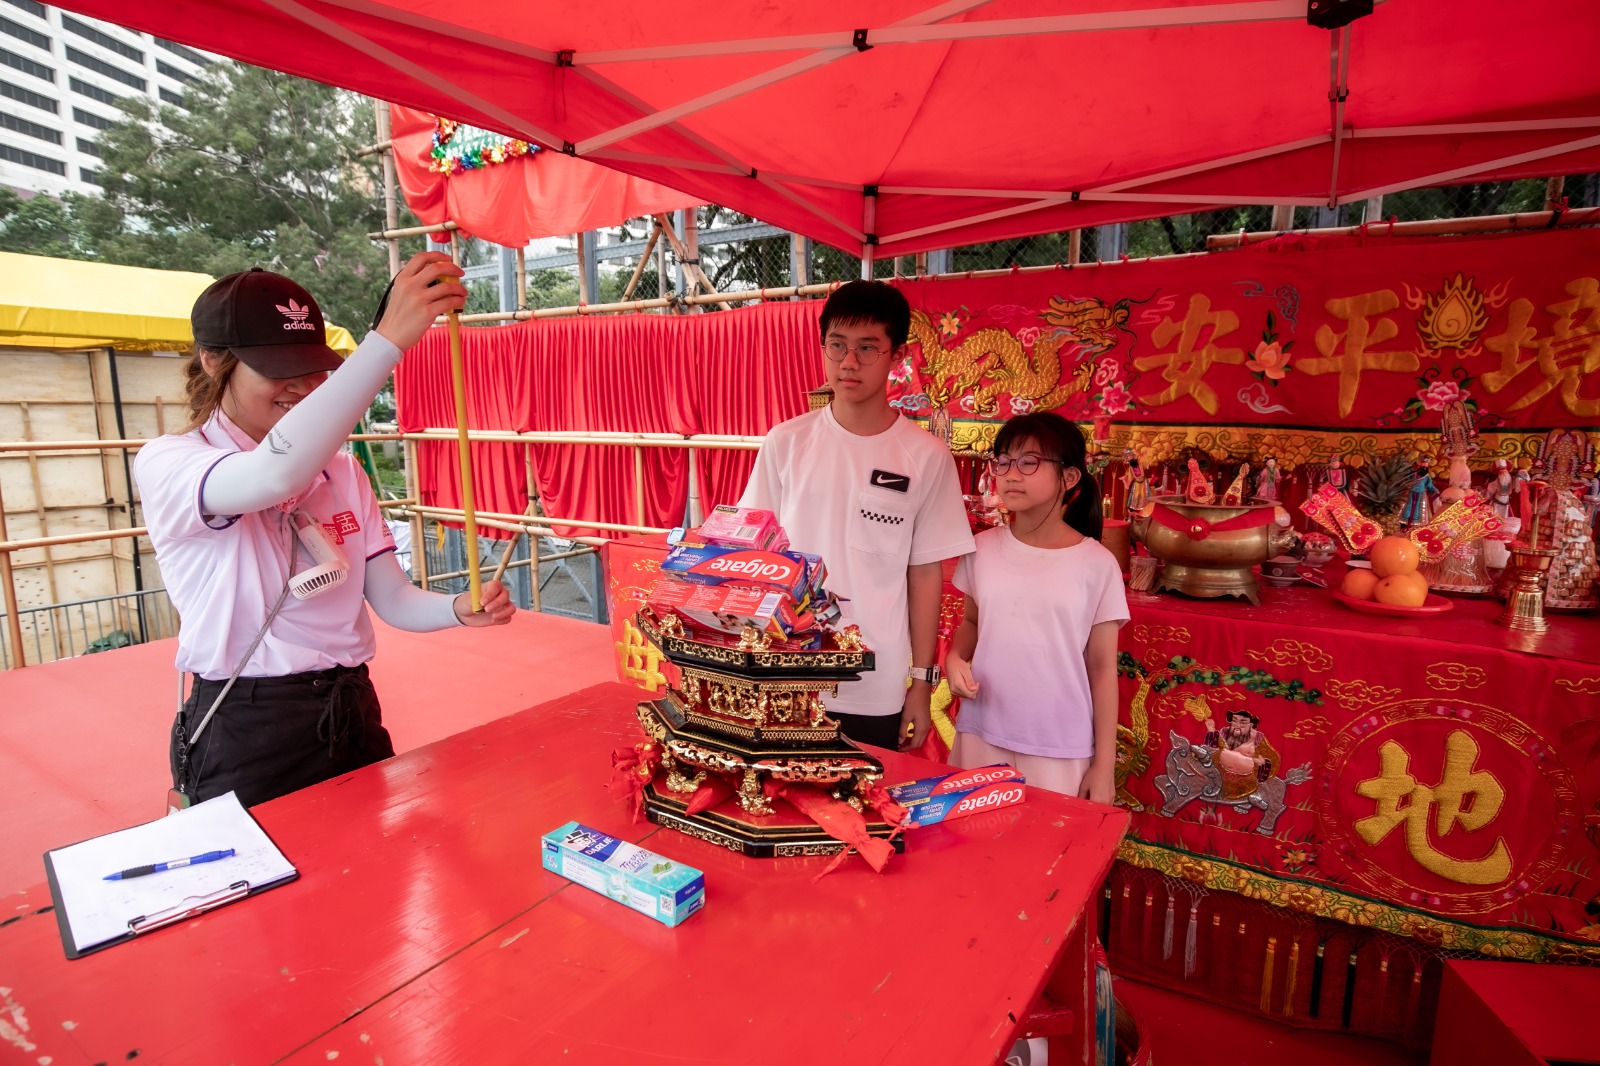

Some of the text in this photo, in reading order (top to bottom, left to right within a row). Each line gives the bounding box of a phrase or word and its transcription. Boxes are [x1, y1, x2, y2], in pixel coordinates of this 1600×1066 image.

[283, 321, 315, 330] adidas
[710, 558, 791, 581] Colgate
[942, 769, 1016, 790] Colgate
[959, 788, 1023, 811] Colgate
[1353, 729, 1513, 885] 地
[584, 836, 614, 856] DARLIE
